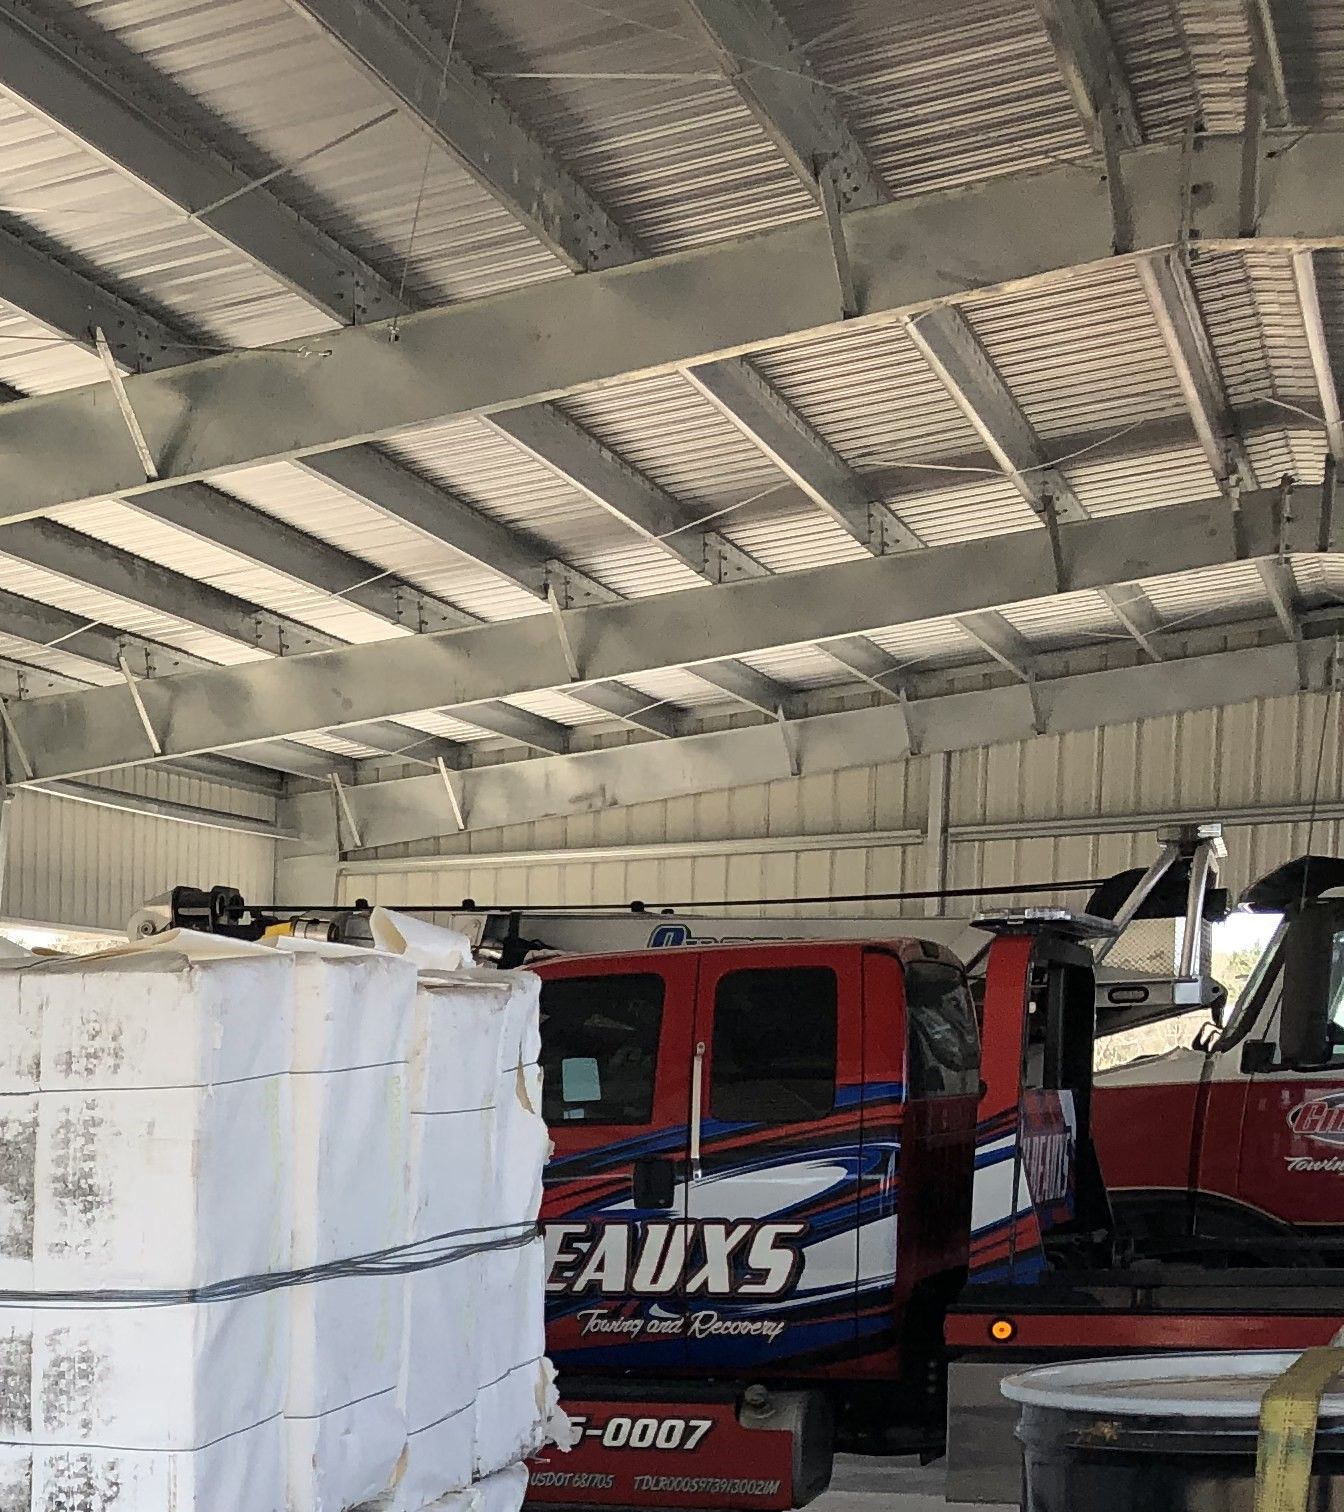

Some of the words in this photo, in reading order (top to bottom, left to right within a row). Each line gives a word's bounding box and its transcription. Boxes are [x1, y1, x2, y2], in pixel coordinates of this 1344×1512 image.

[577, 1309, 644, 1338] Towing
[647, 1316, 685, 1335] and
[687, 1310, 785, 1343] Recovery
[531, 1472, 573, 1487] USDOT
